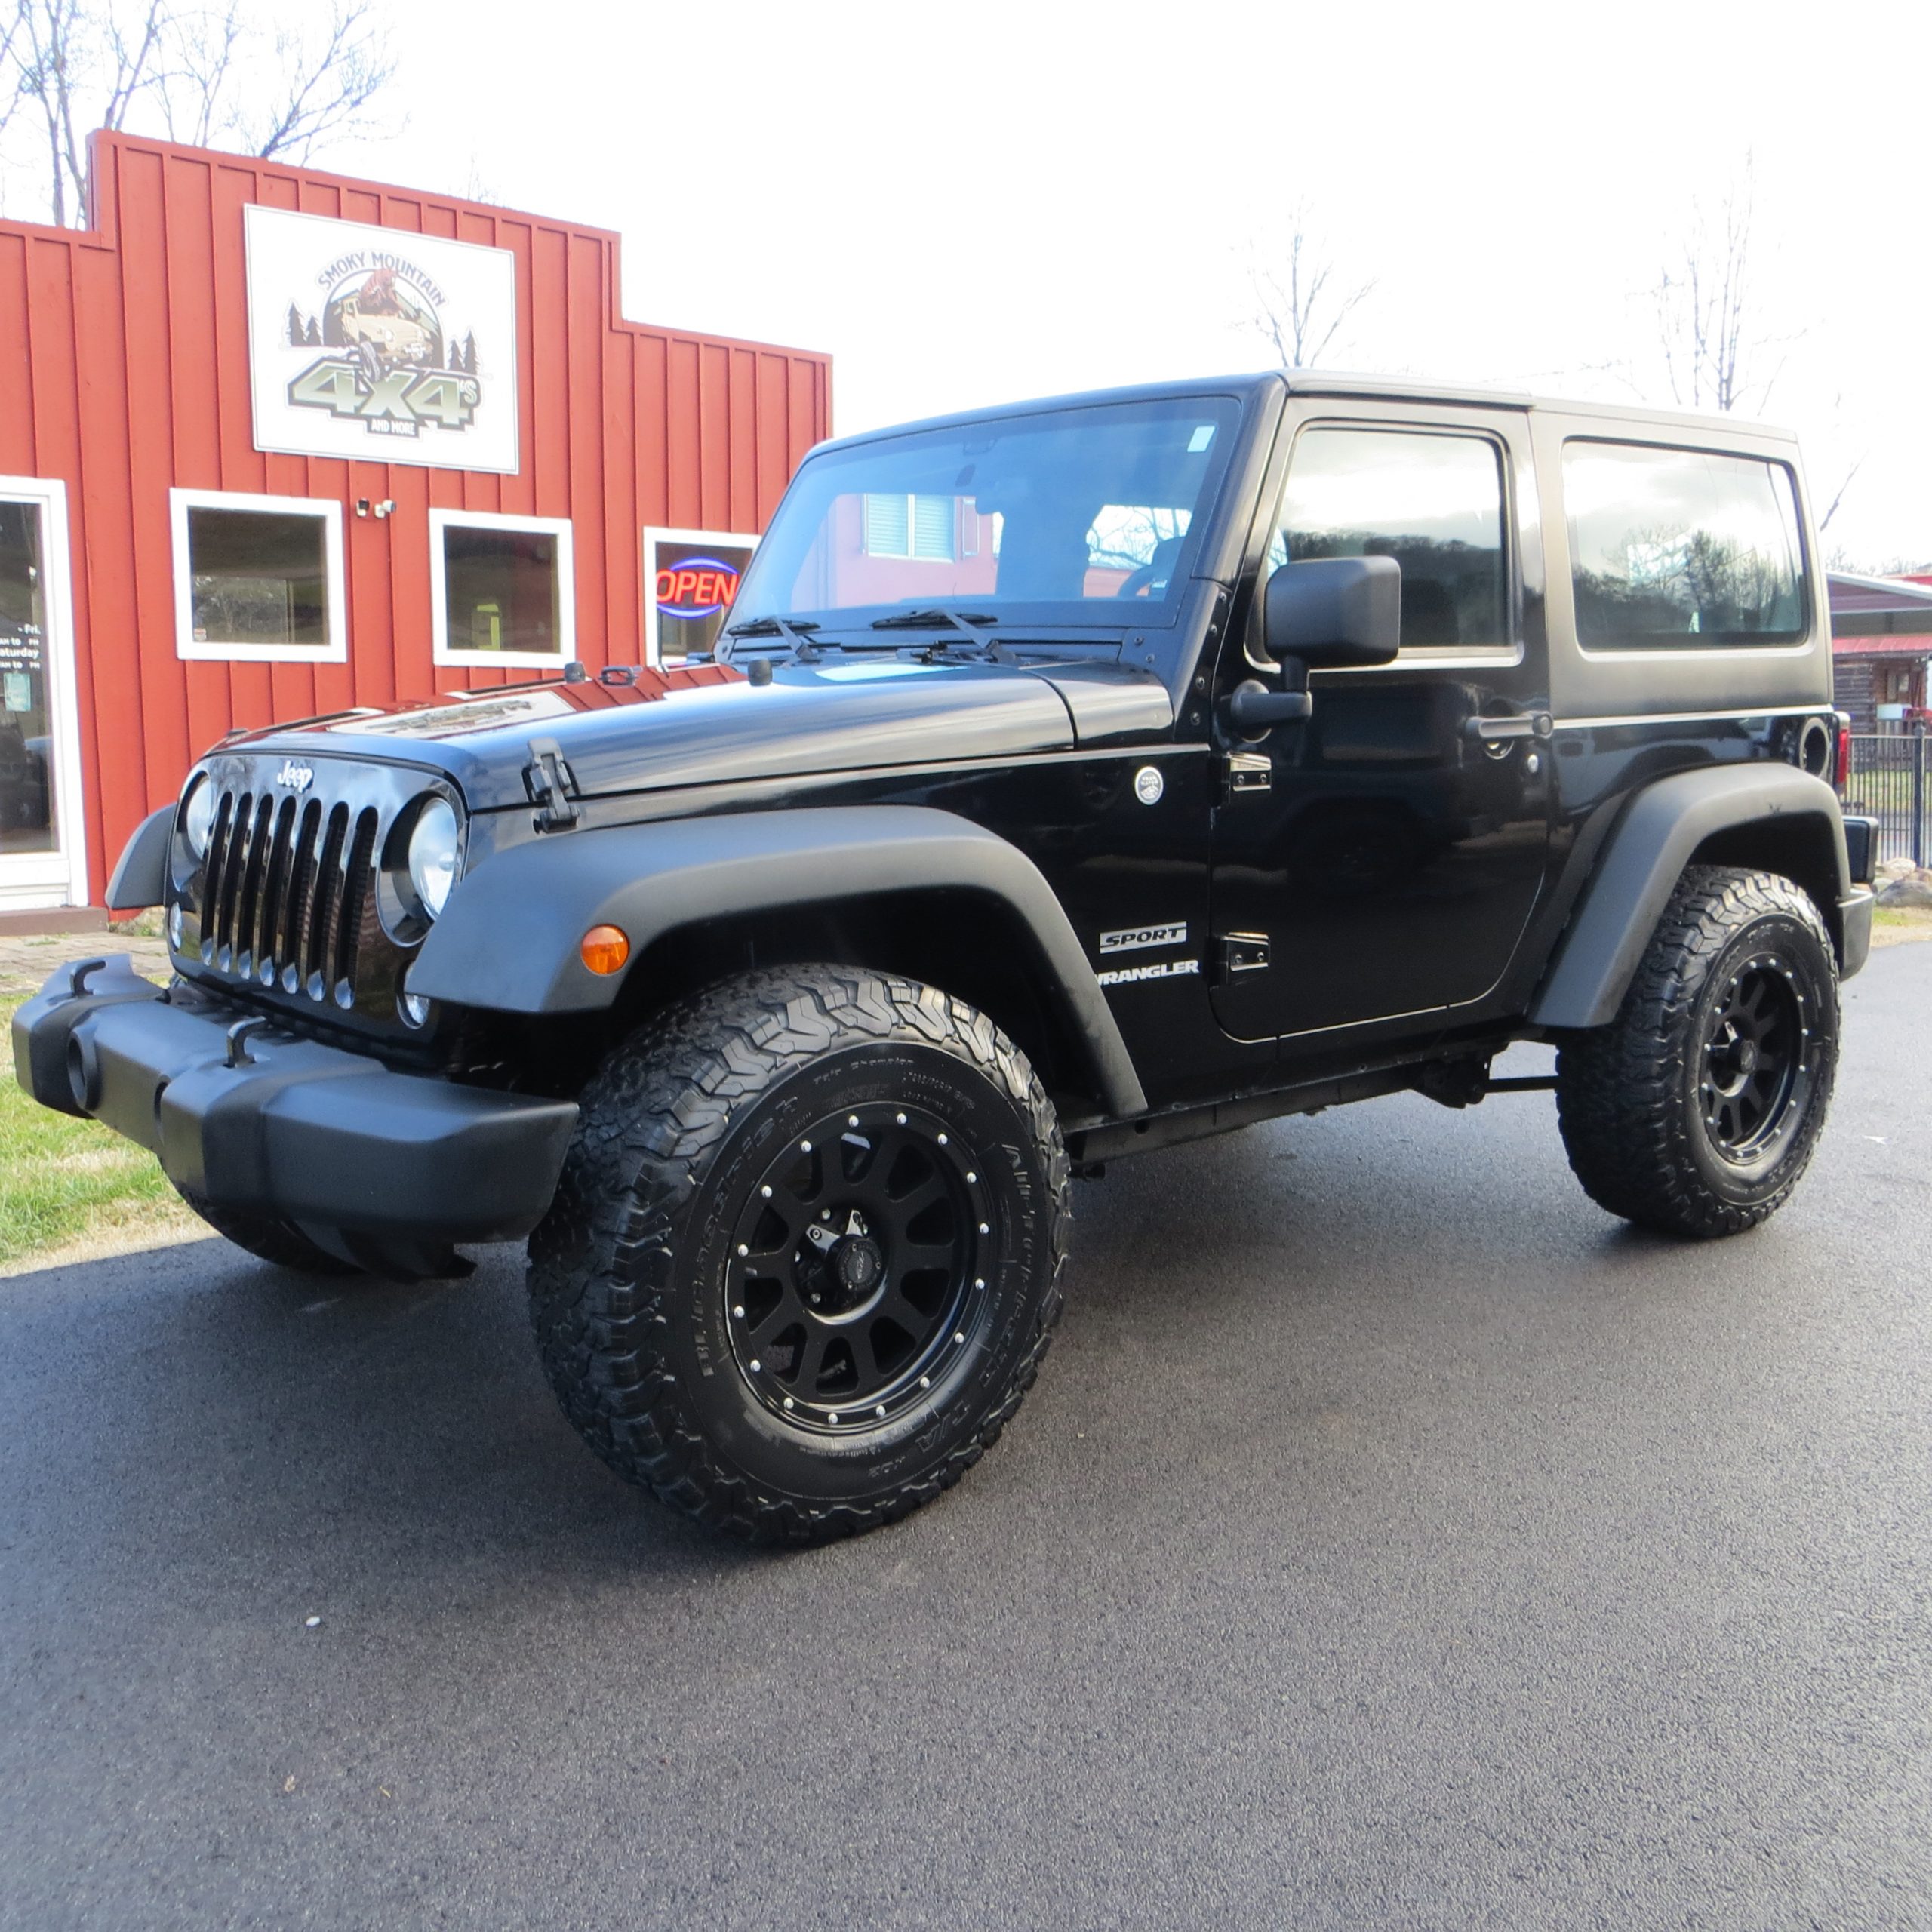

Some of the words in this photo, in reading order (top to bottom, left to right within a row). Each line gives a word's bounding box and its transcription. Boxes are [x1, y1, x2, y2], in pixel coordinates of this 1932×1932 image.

[318, 252, 365, 290] SMOKY
[371, 251, 446, 307] MOUNTAIN
[371, 419, 389, 432] AND
[392, 420, 415, 435] MORE
[656, 568, 740, 606] OPEN
[24, 623, 41, 635] Fri.
[11, 637, 21, 646] to
[0, 647, 39, 660] aturday
[12, 660, 23, 669] to
[277, 760, 313, 793] Jeep
[1105, 928, 1178, 947] SPORT
